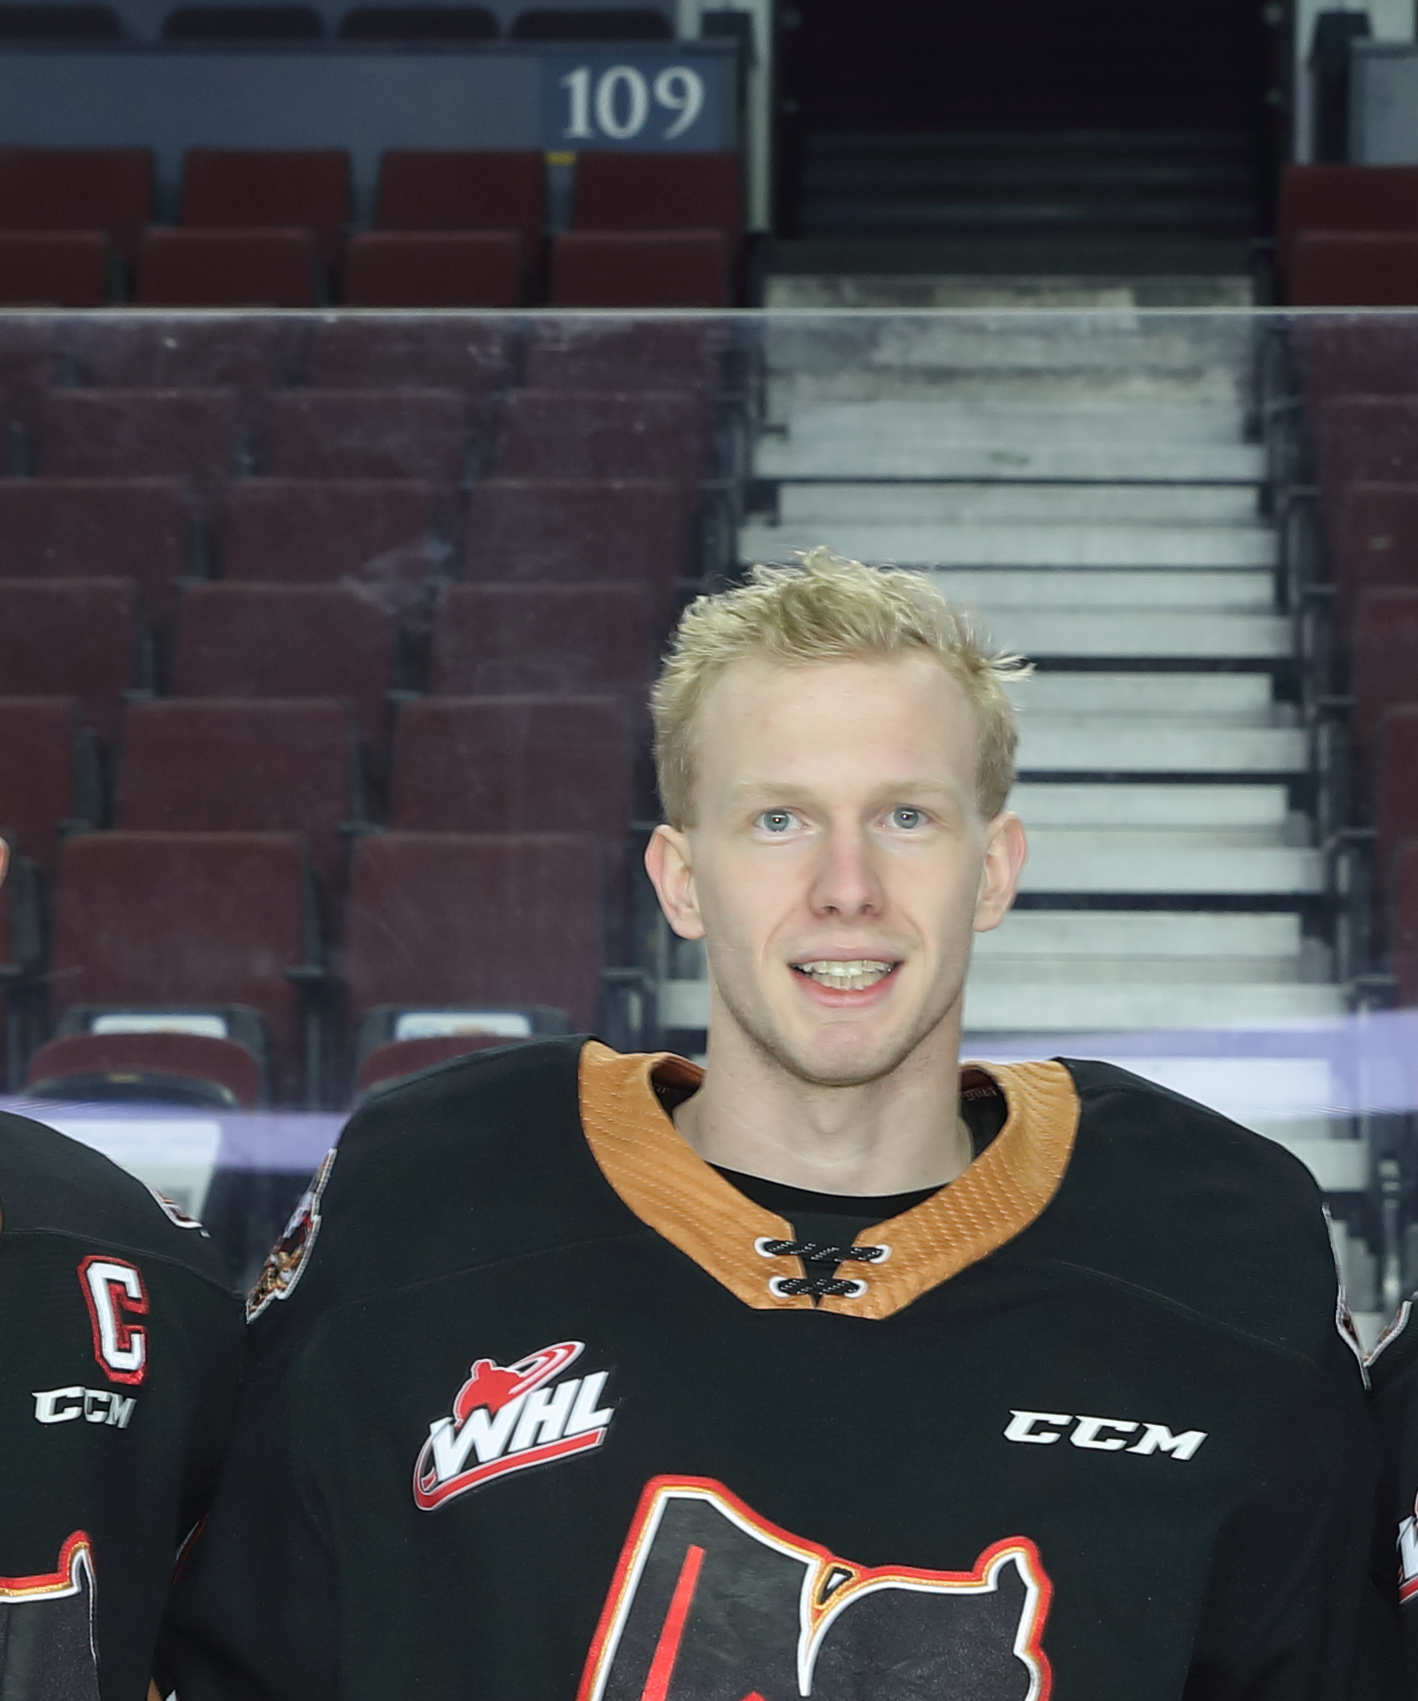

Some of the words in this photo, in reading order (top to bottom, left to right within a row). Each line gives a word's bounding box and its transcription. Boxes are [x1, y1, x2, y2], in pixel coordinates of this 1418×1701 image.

[560, 65, 705, 140] 109
[76, 1255, 149, 1385] C
[32, 1386, 137, 1428] CCM
[430, 1370, 615, 1483] WHL
[1003, 1409, 1209, 1461] CCM
